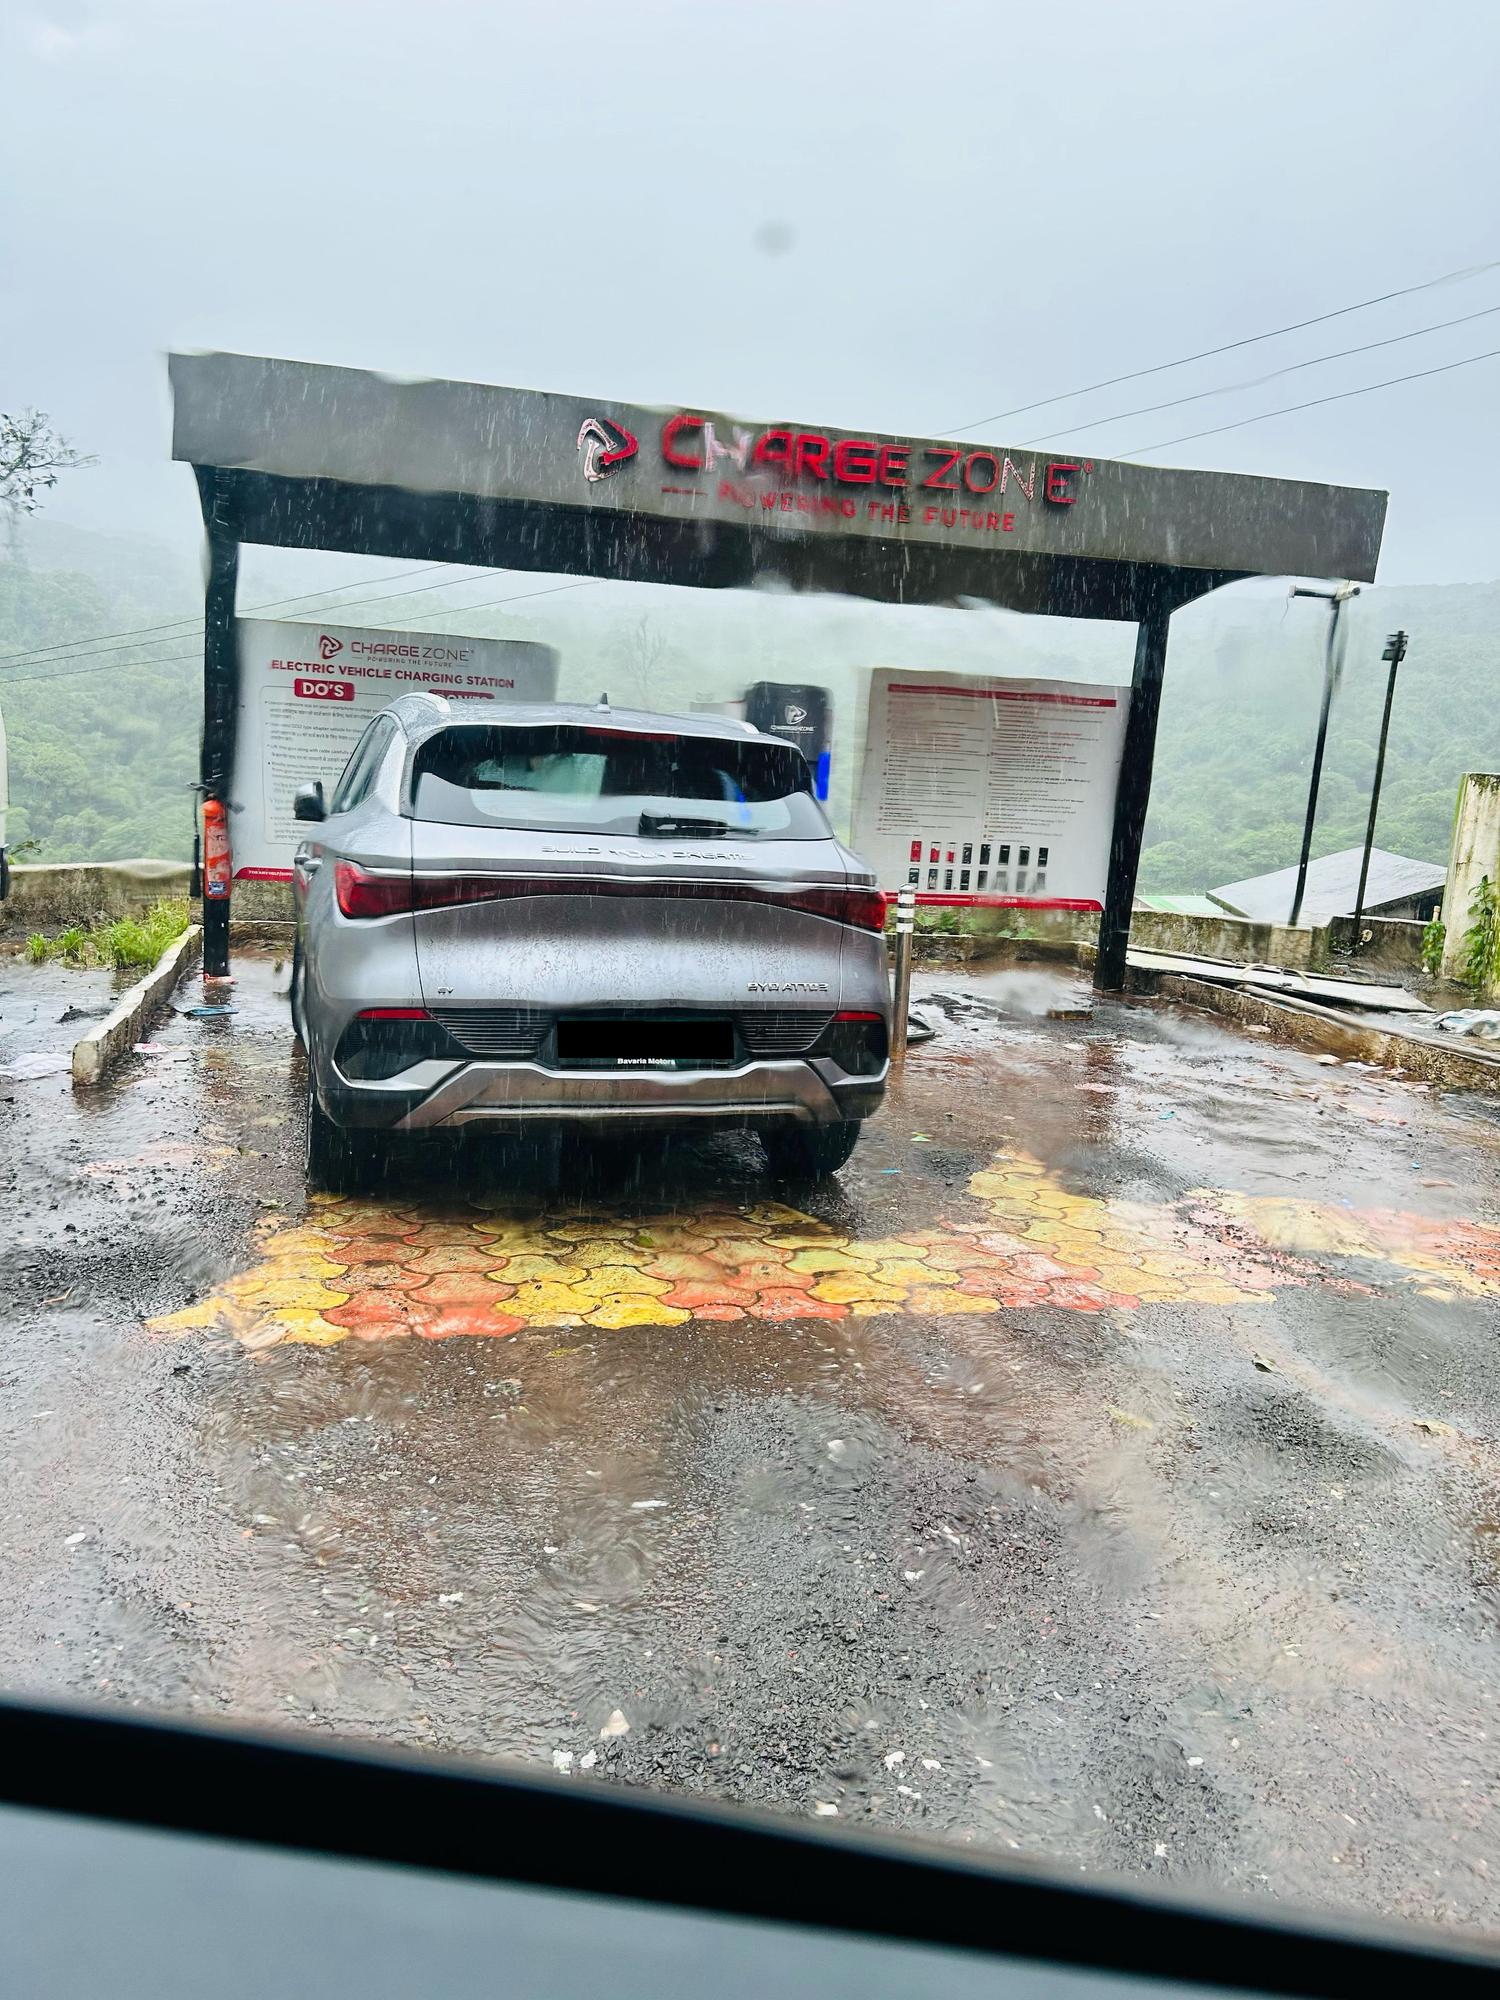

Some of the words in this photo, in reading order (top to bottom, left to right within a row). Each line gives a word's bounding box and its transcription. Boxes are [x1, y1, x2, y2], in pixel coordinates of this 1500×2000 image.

[868, 501, 913, 524] THE
[923, 506, 1015, 531] FUTURE
[271, 659, 335, 674] ELECTRIC
[340, 665, 392, 678] VEHICLE
[394, 670, 463, 684] CHARGING
[466, 675, 514, 688] STATION
[302, 683, 345, 697] DO'S
[747, 982, 780, 992] BYD
[617, 1057, 647, 1065] Bavaria
[647, 1057, 676, 1066] Motors
